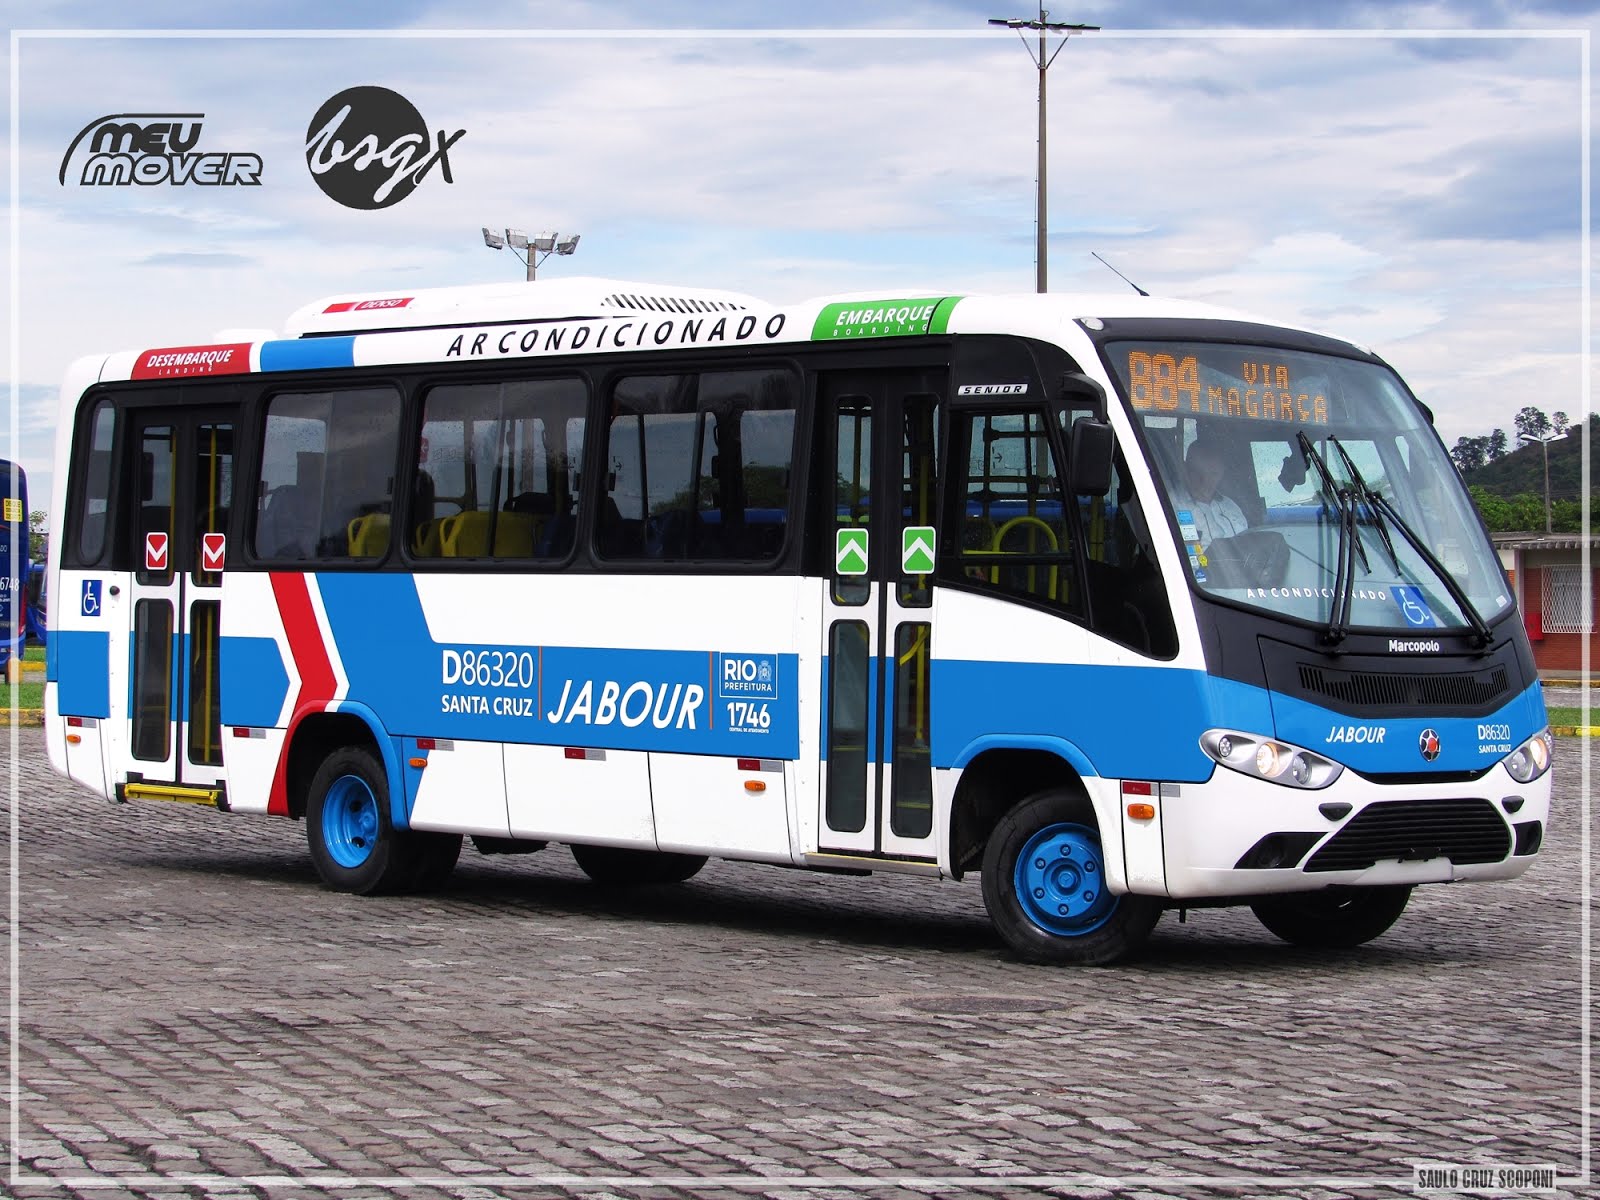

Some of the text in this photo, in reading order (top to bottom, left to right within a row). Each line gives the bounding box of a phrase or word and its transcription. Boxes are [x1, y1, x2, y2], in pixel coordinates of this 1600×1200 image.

[835, 305, 935, 326] EMBARQUE
[446, 313, 787, 357] AR CONDICIONADO
[833, 323, 928, 337] BOARDING
[146, 349, 235, 368] DESEMBARQUE
[158, 365, 214, 376] LANDING
[1242, 362, 1290, 390] VIA
[963, 384, 1023, 395] SENIOR
[1247, 587, 1267, 599] AR
[1388, 639, 1440, 652] Marcopolo
[441, 650, 534, 689] D86320
[724, 659, 757, 681] RIO
[724, 682, 773, 692] PREFEITURA
[441, 694, 534, 717] SANTA CRUZ
[547, 679, 704, 730] JABOUR
[727, 702, 771, 728] 1746
[1325, 726, 1386, 744] JABOUR
[1477, 724, 1511, 740] D86320
[1478, 743, 1511, 754] SANTA CRUZ
